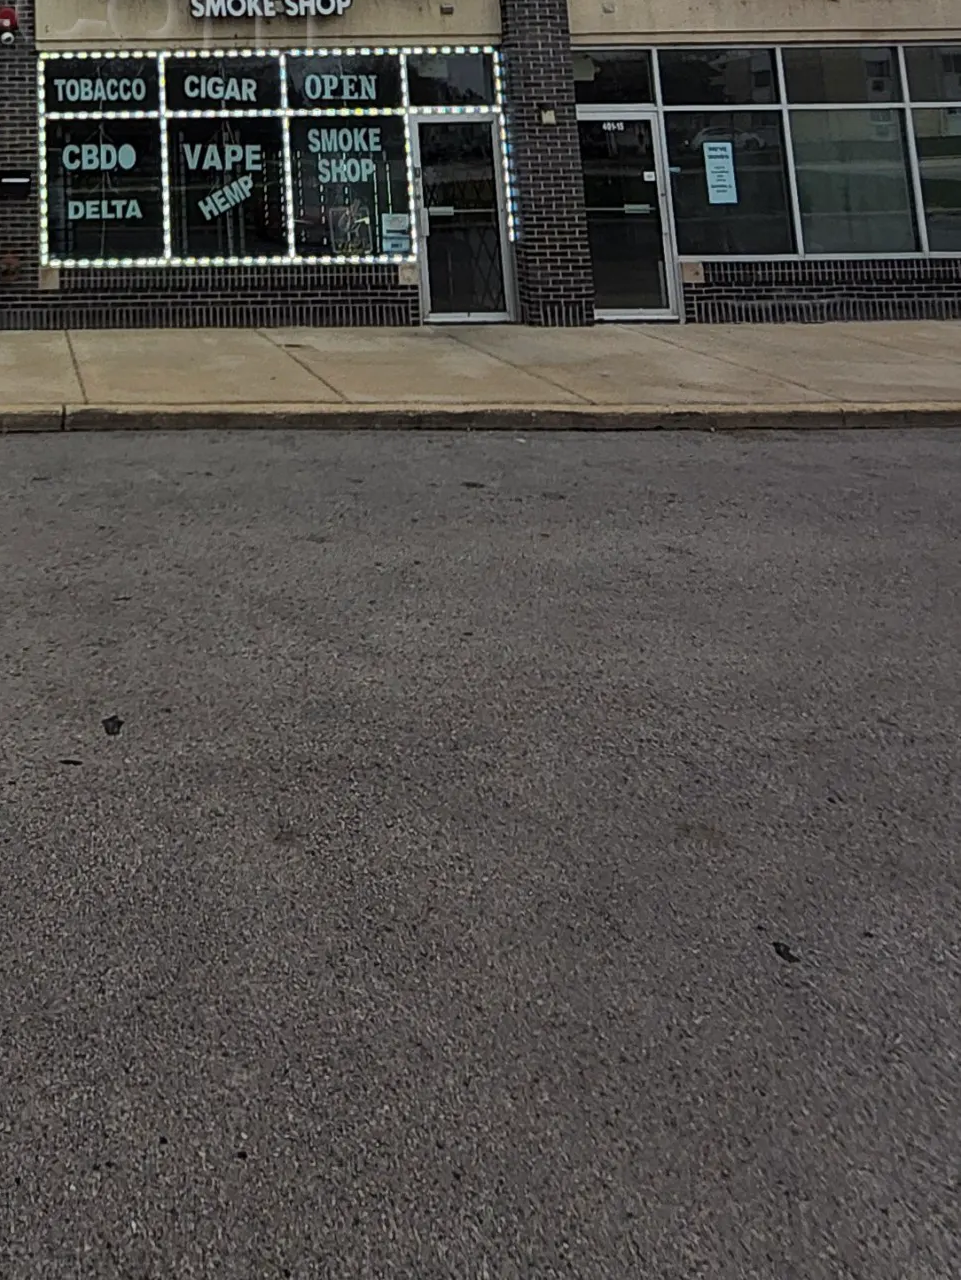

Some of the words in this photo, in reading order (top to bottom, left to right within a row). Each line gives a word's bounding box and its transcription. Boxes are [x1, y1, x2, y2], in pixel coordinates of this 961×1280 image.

[54, 78, 147, 102] TOBACCO
[184, 75, 257, 102] CIGAR
[304, 74, 377, 100] OPEN
[307, 127, 382, 153] SMOKE
[183, 143, 262, 171] VAPE
[318, 158, 375, 183] SHOP
[68, 199, 143, 220] DELTA
[198, 174, 254, 220] HEMP
